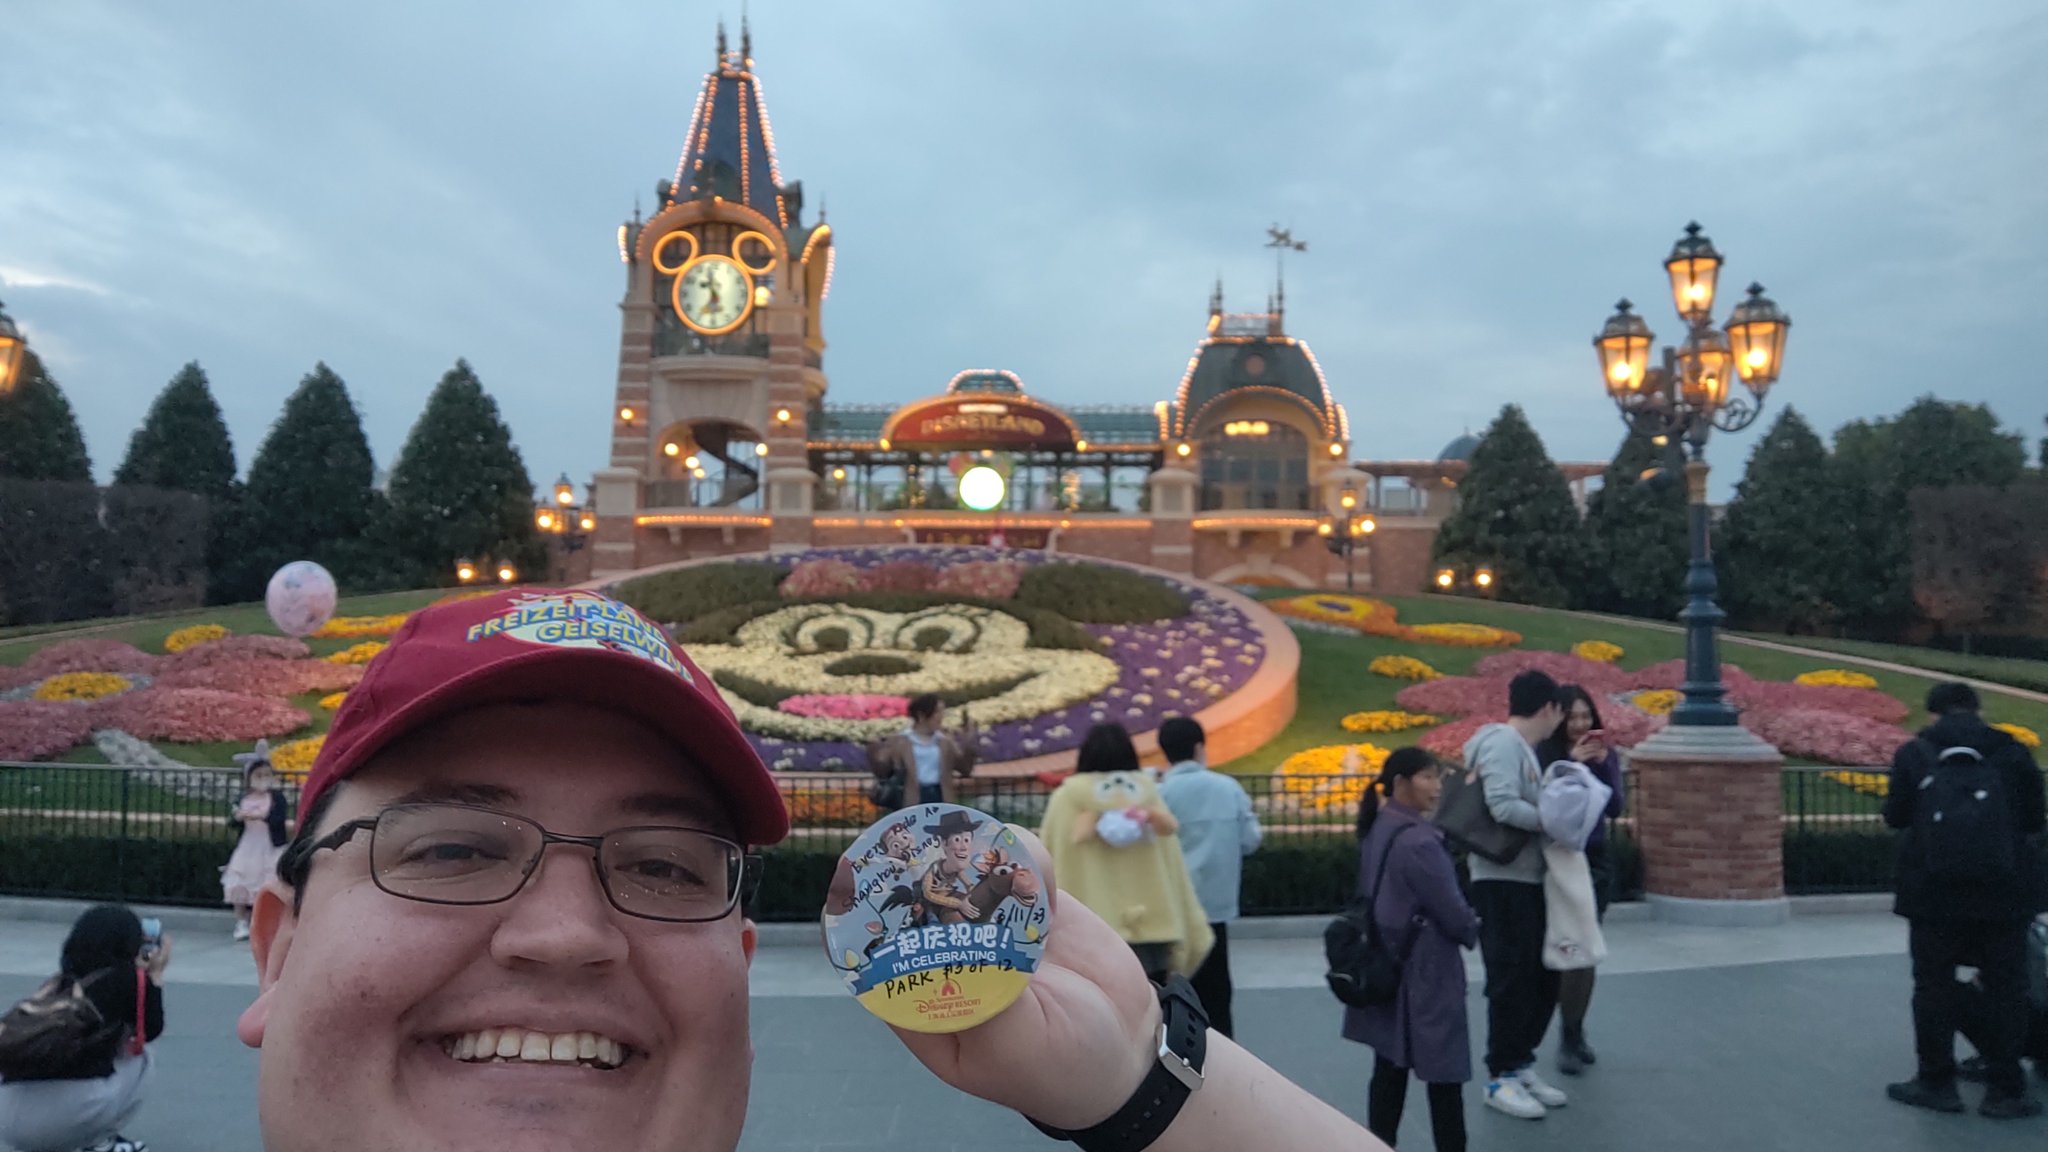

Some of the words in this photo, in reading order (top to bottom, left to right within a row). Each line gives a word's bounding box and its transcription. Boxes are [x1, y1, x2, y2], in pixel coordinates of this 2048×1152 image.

[466, 602, 669, 644] FREIZEIT-LAND
[537, 621, 694, 684] GEISELWIND
[872, 923, 1011, 959] 一起庆祝吧！
[892, 961, 910, 975] I'M
[911, 949, 997, 967] CELEBRATING
[884, 970, 934, 999] PARK
[997, 957, 1014, 972] 12
